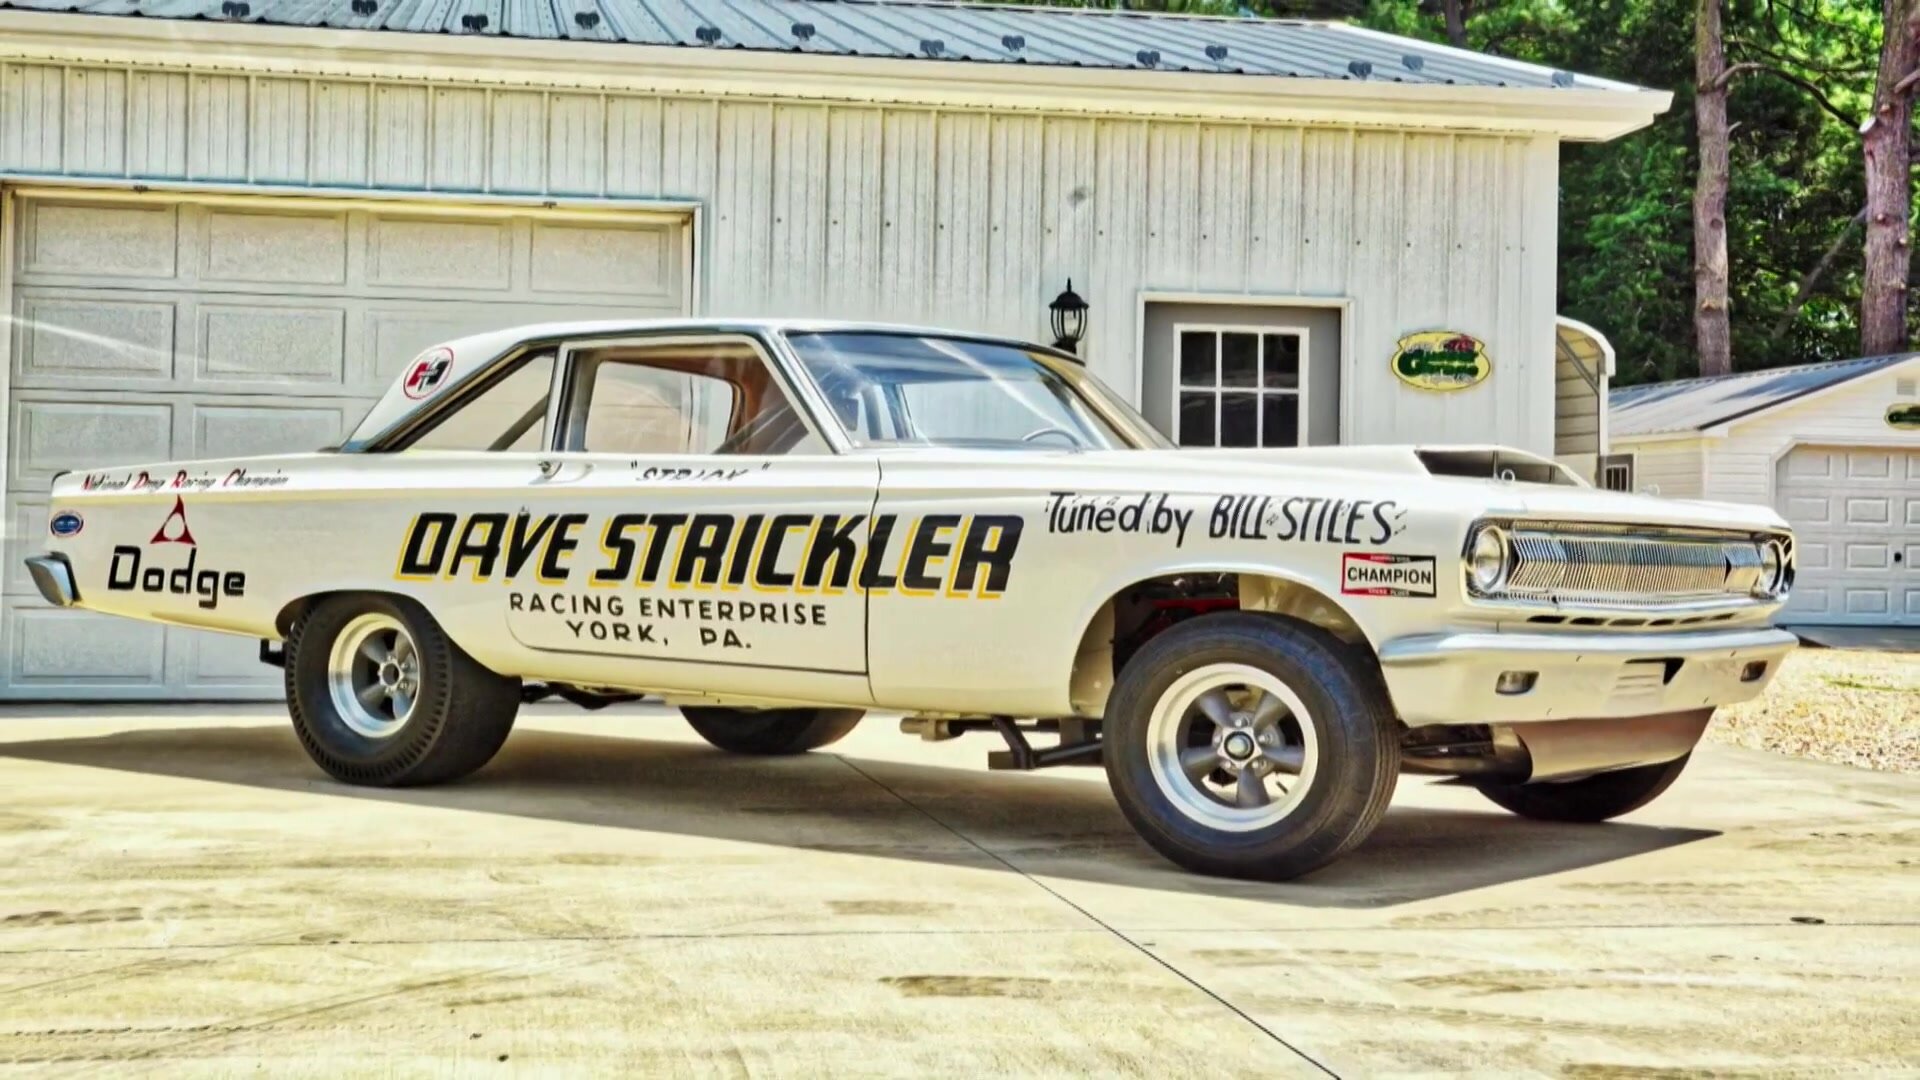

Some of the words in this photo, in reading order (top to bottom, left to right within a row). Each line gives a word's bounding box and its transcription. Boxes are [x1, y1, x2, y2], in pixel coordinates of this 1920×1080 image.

[1047, 491, 1149, 533] Tuned
[1151, 493, 1194, 547] by
[1209, 495, 1267, 539] BILL
[1276, 497, 1397, 546] STILES
[108, 545, 246, 609] Dodge
[394, 512, 589, 584] DAVE
[589, 513, 1024, 599] STRICKLER
[1347, 566, 1432, 585] CHAMPION
[509, 592, 625, 617] RACING
[639, 597, 827, 626] ENTERPRISE
[566, 620, 669, 646] YORK,
[699, 627, 752, 649] PA.
